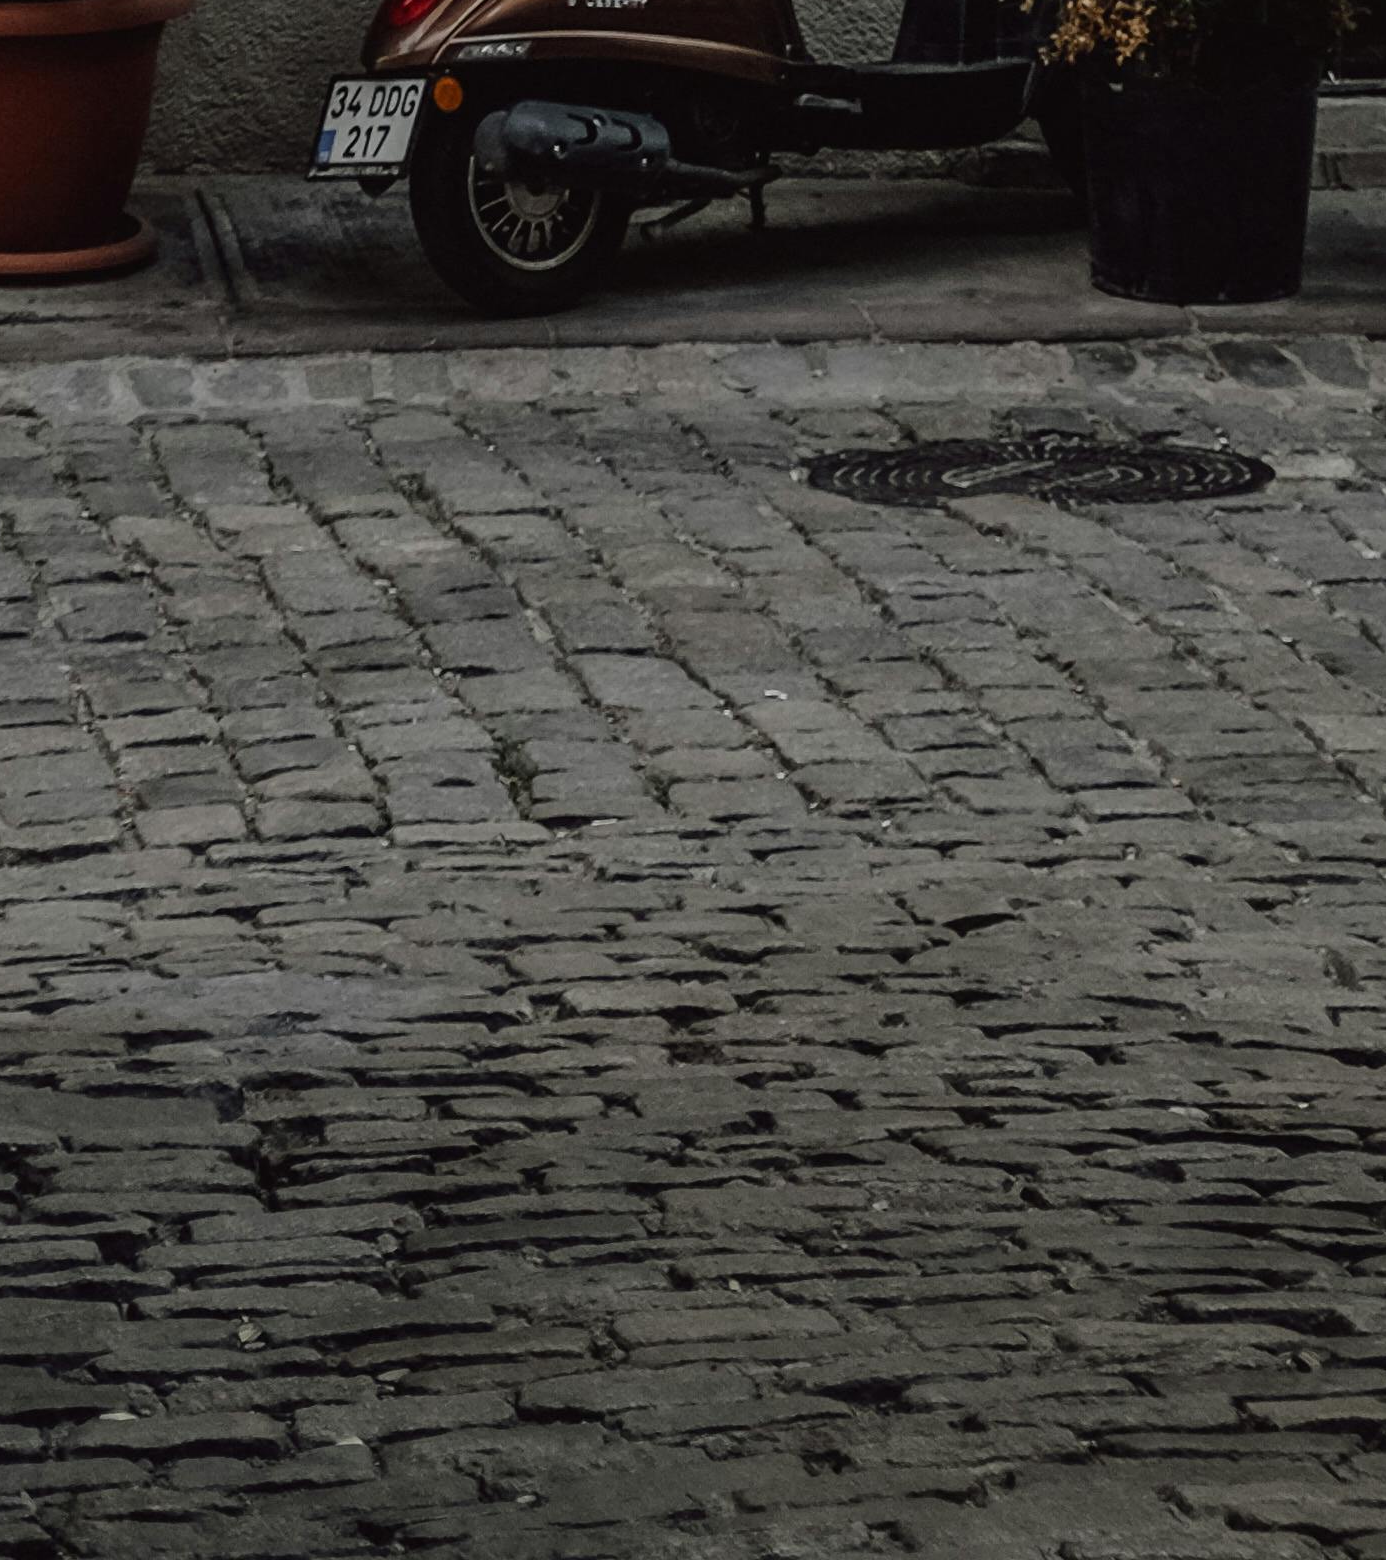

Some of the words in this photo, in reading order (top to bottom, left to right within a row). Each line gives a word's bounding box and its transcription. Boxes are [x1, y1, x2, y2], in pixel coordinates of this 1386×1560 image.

[331, 86, 362, 118] 34
[368, 85, 418, 117] DDG
[343, 125, 390, 158] 217
